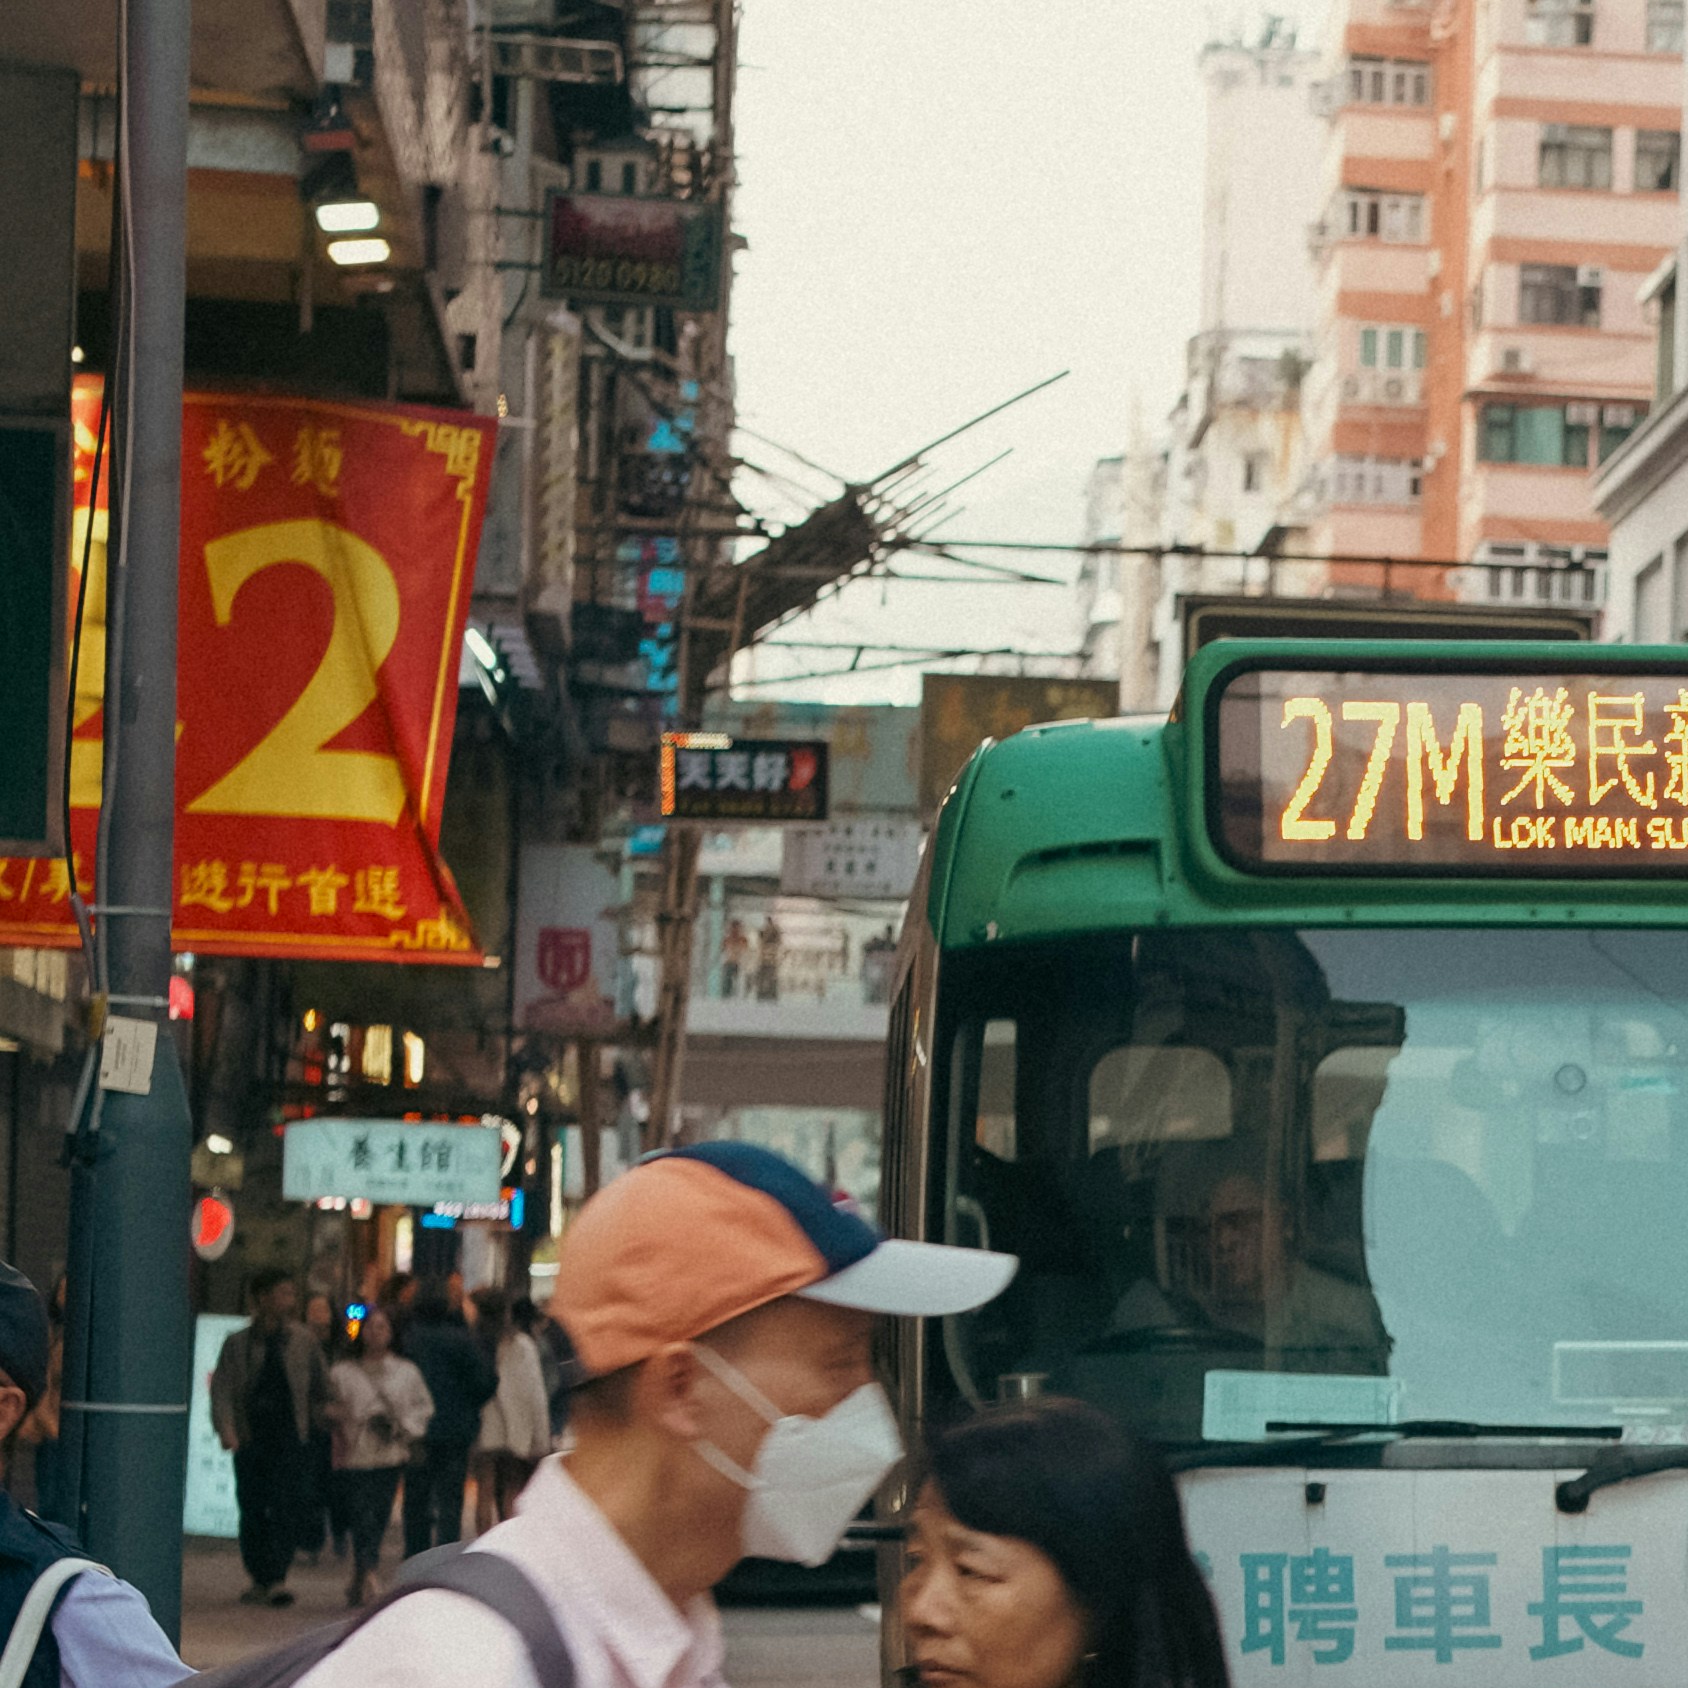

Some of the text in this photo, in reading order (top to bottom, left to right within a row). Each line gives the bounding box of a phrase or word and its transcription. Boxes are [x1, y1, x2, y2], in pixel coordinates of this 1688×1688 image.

[1281, 697, 1484, 841] 27M
[1494, 816, 1555, 849] LOK
[1564, 816, 1641, 849] MAN
[1195, 1545, 1646, 1667] 聘車長
